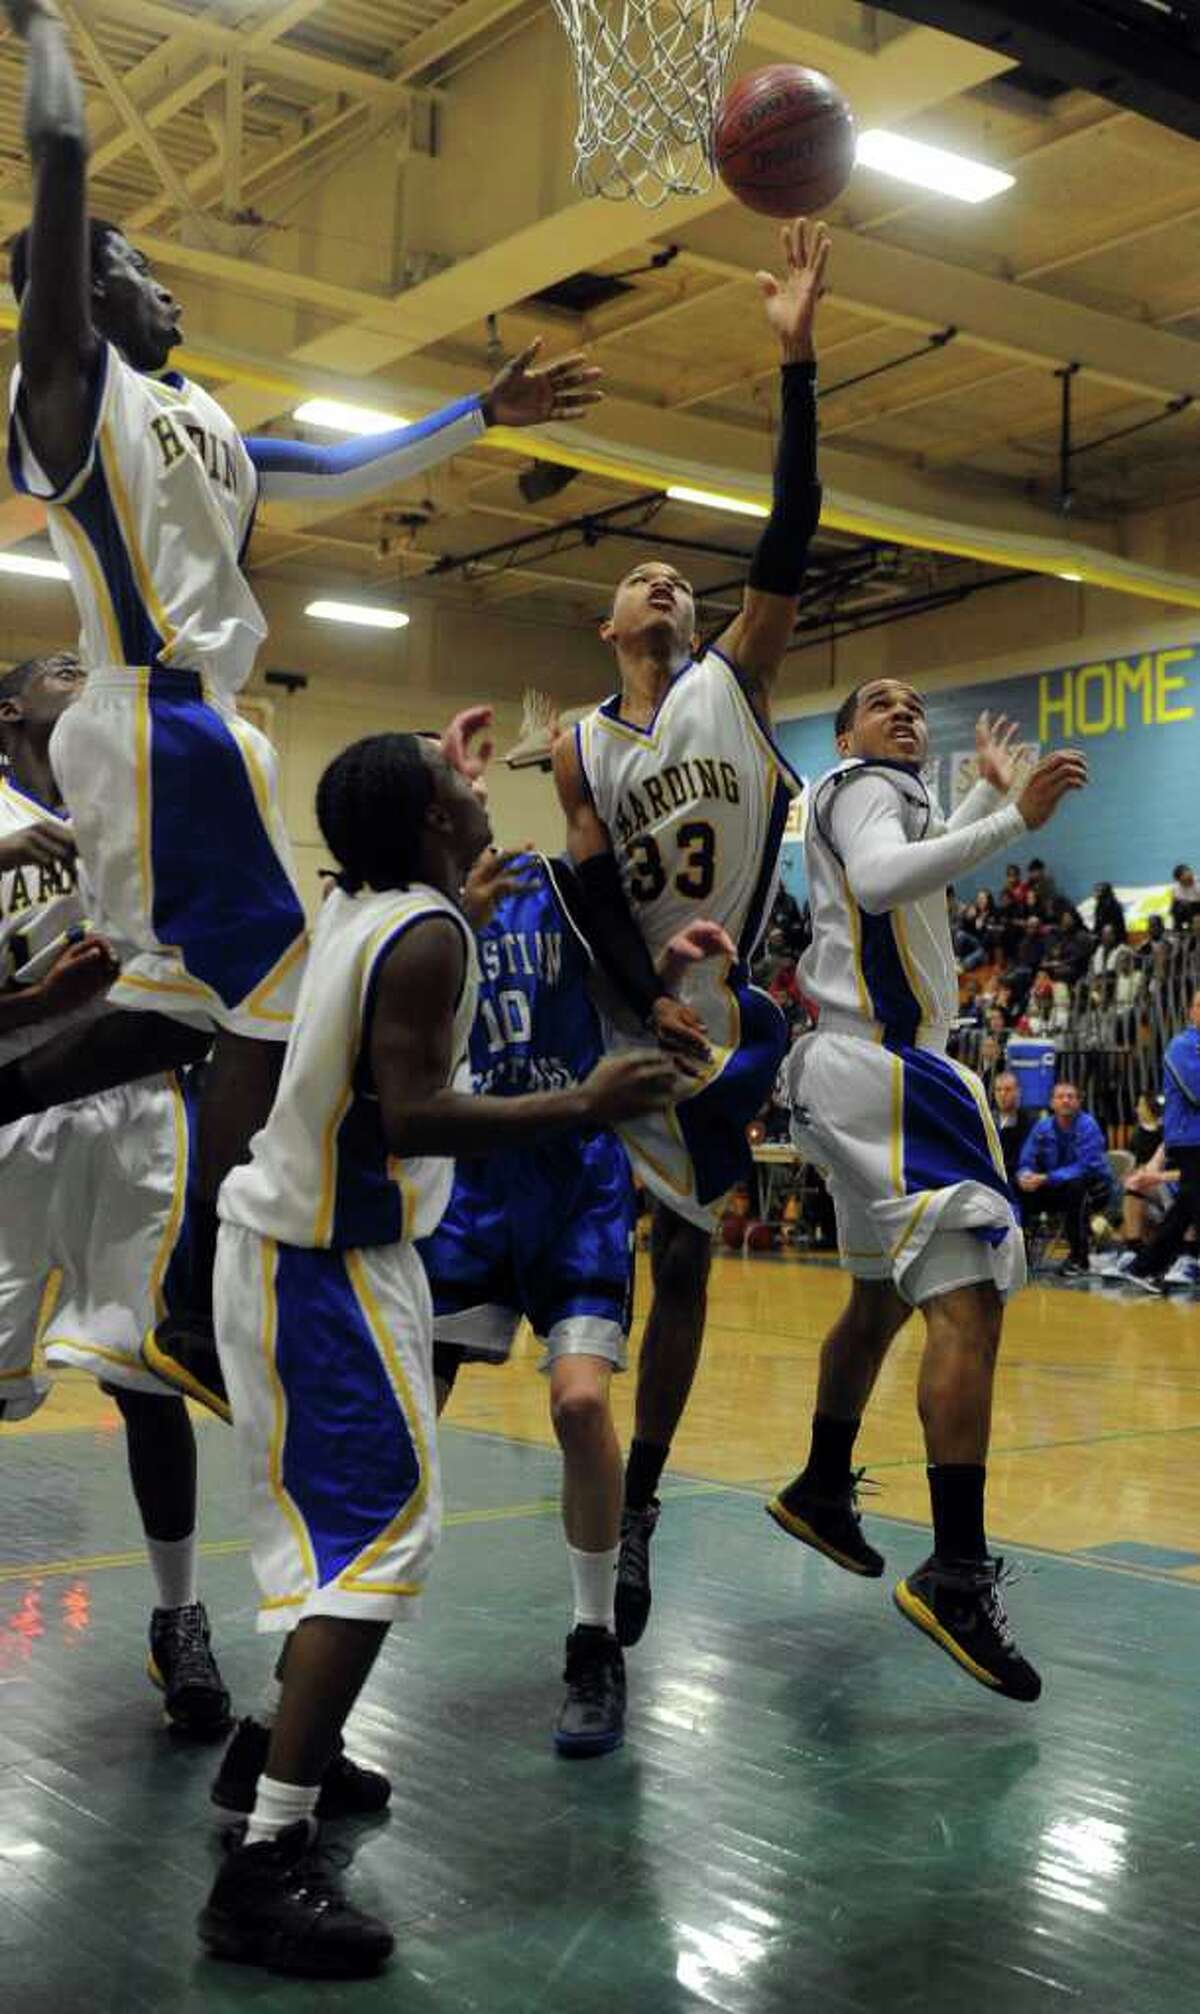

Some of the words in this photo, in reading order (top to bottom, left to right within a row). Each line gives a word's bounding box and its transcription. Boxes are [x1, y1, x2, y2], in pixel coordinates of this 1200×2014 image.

[1037, 647, 1196, 741] HOME
[624, 818, 723, 902] 33
[481, 990, 532, 1053] 10
